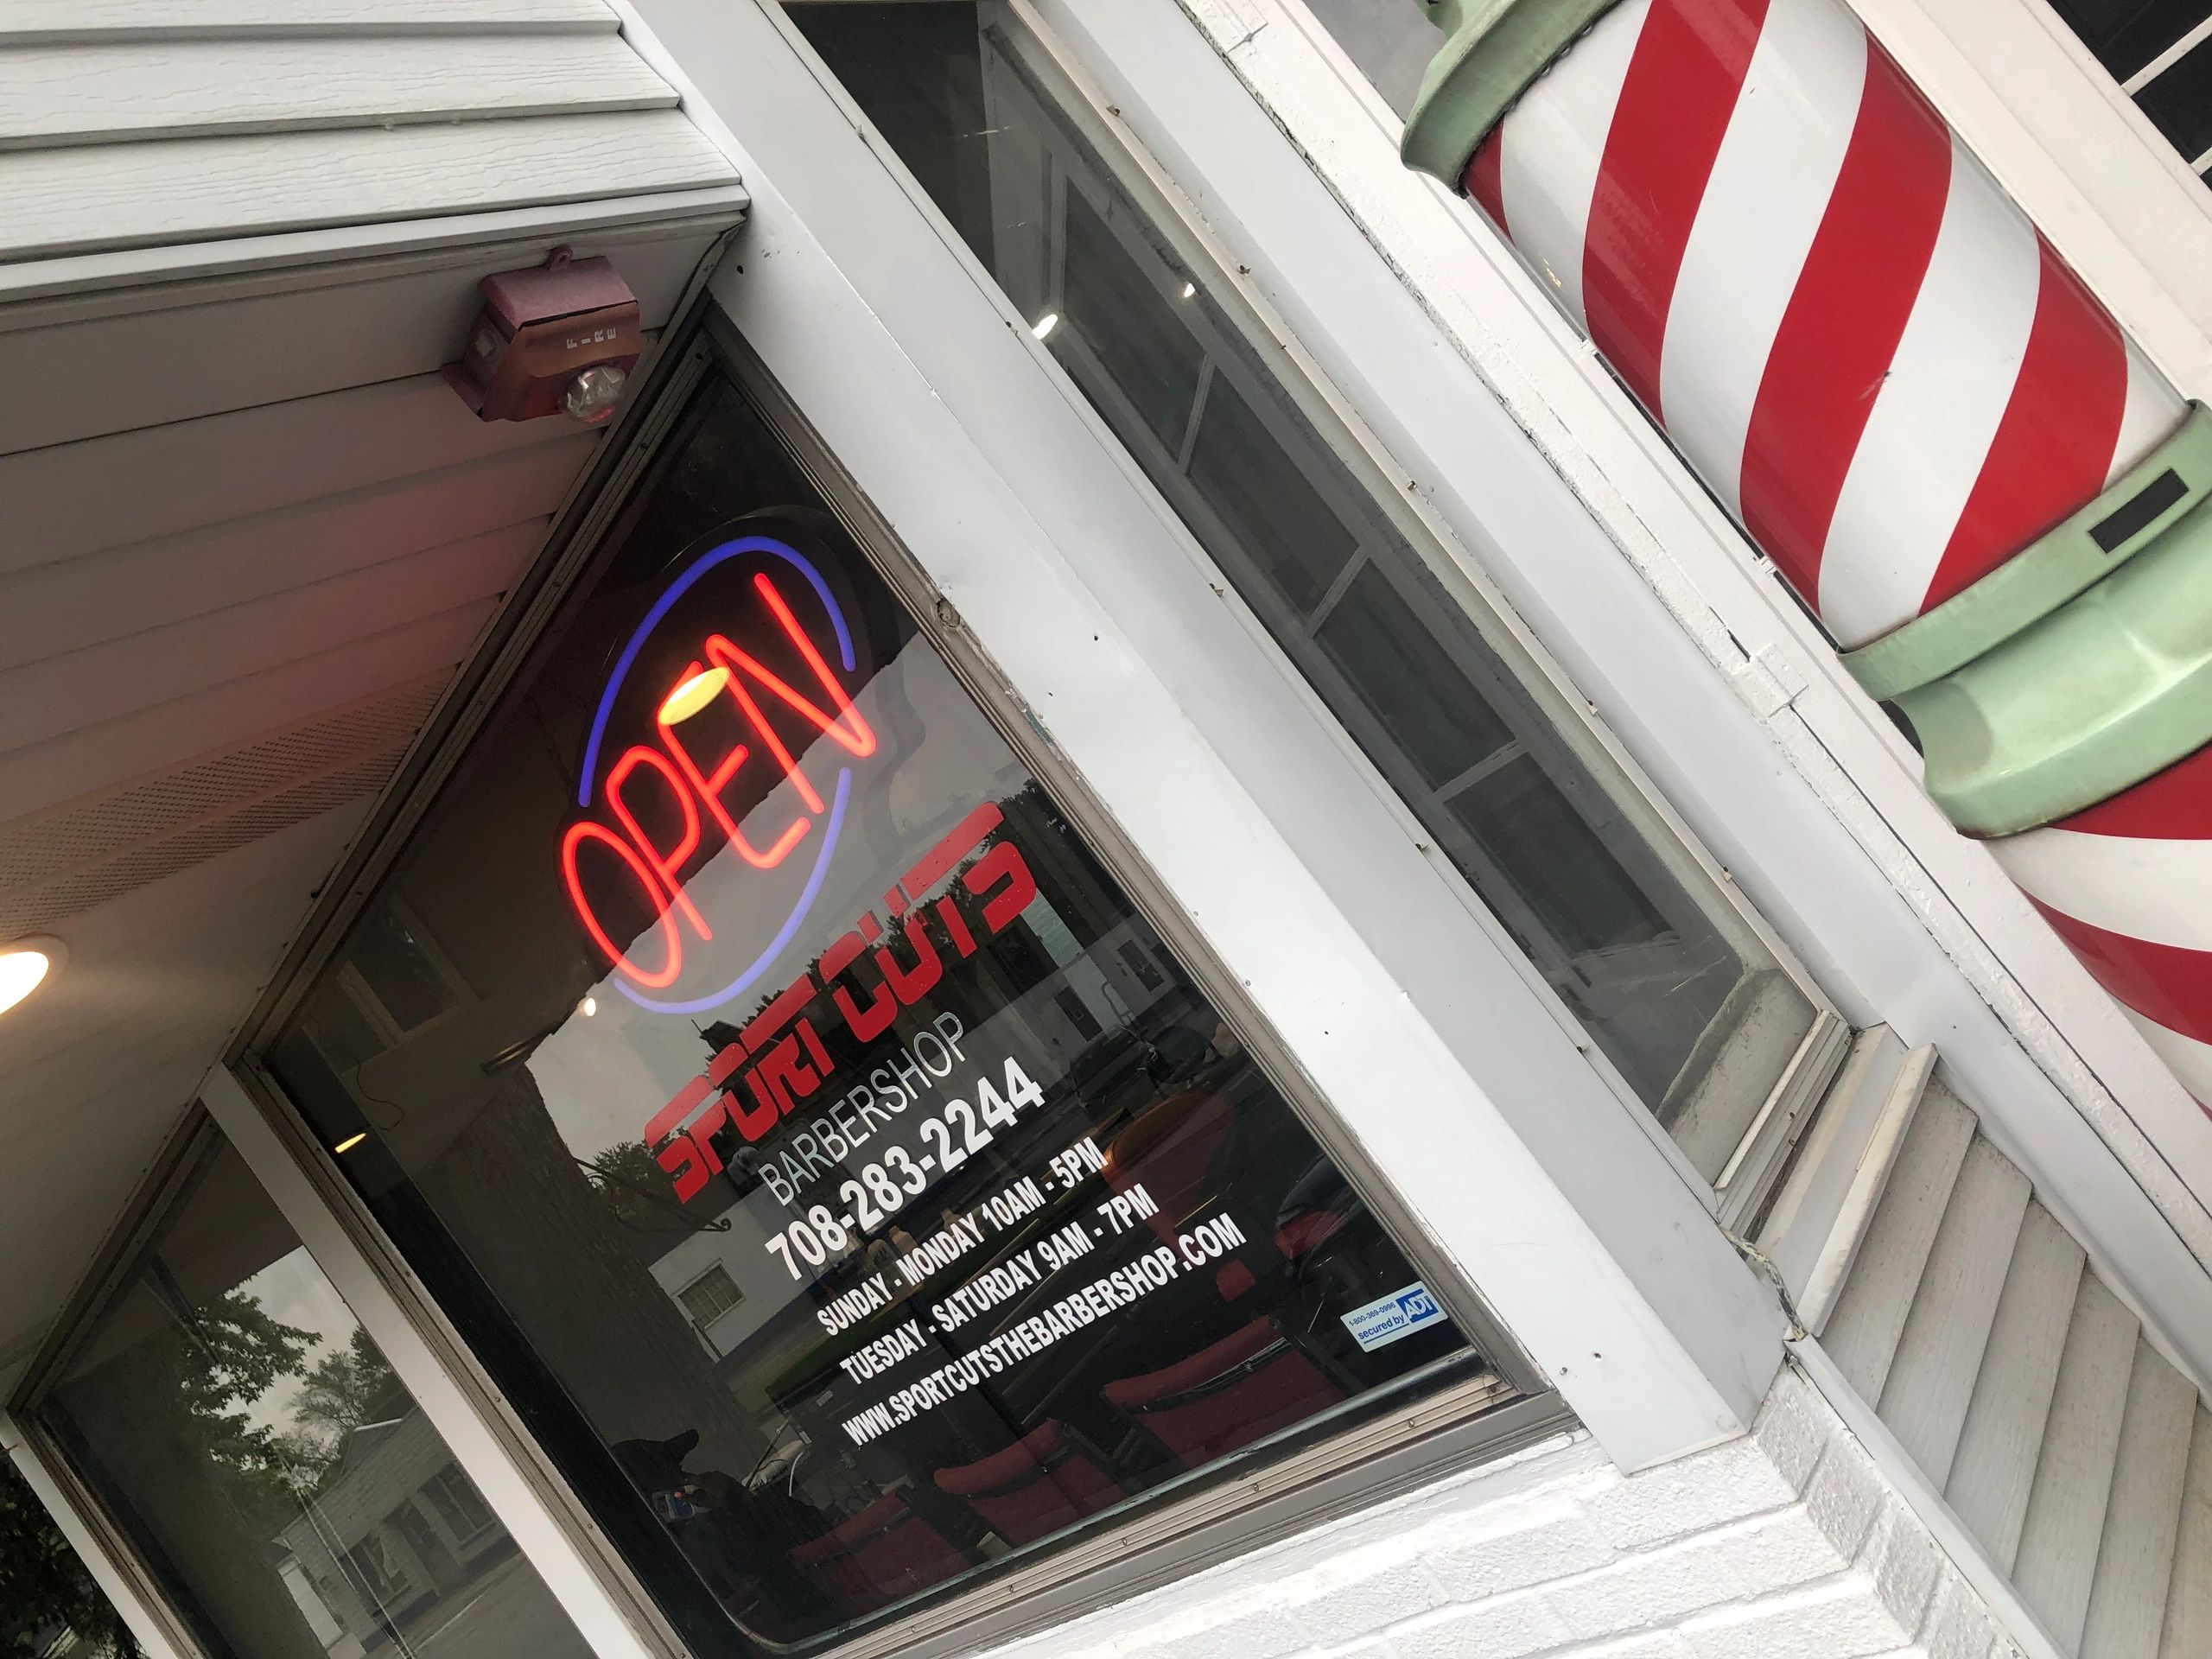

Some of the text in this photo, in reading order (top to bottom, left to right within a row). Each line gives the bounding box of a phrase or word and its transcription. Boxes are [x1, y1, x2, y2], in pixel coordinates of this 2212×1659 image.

[567, 327, 616, 349] FIRE
[563, 573, 876, 988] OPEN
[644, 801, 1036, 1204] SPORT CUTS
[758, 1012, 966, 1206] BARBERSHOP
[764, 1056, 1046, 1281] 708-283-2244
[817, 1272, 893, 1336] SUNDAY
[896, 1212, 985, 1287] MONDAY
[982, 1175, 1046, 1232] 10AM
[1049, 1136, 1109, 1189] 5PM
[840, 1319, 927, 1386] TUESDAY
[931, 1249, 1043, 1332] SATURDAY
[1037, 1221, 1096, 1270] 9AM
[1097, 1183, 1160, 1235] 7PM
[842, 1212, 1247, 1446] WWW.SPORTCUTSTHEBARBERSHOP.COM
[1357, 1294, 1435, 1339] secured by ADT
